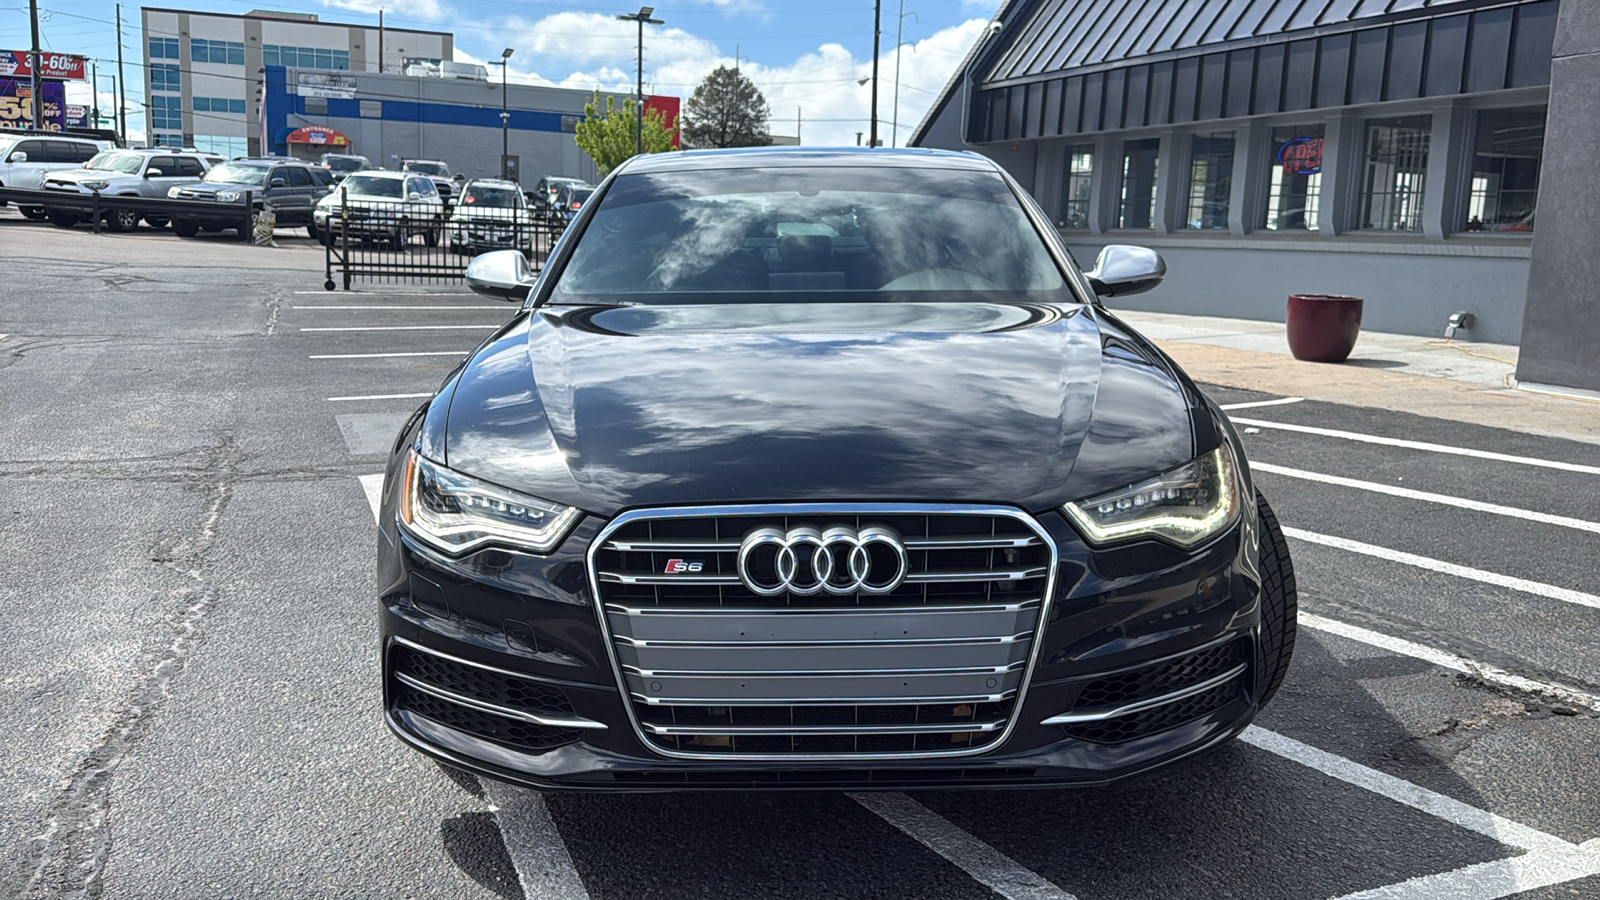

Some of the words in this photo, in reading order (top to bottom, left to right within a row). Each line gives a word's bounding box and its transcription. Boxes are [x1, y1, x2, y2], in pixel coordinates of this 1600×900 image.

[45, 109, 61, 117] OFF
[301, 125, 335, 135] ENTRANCE
[672, 561, 704, 573] S6
